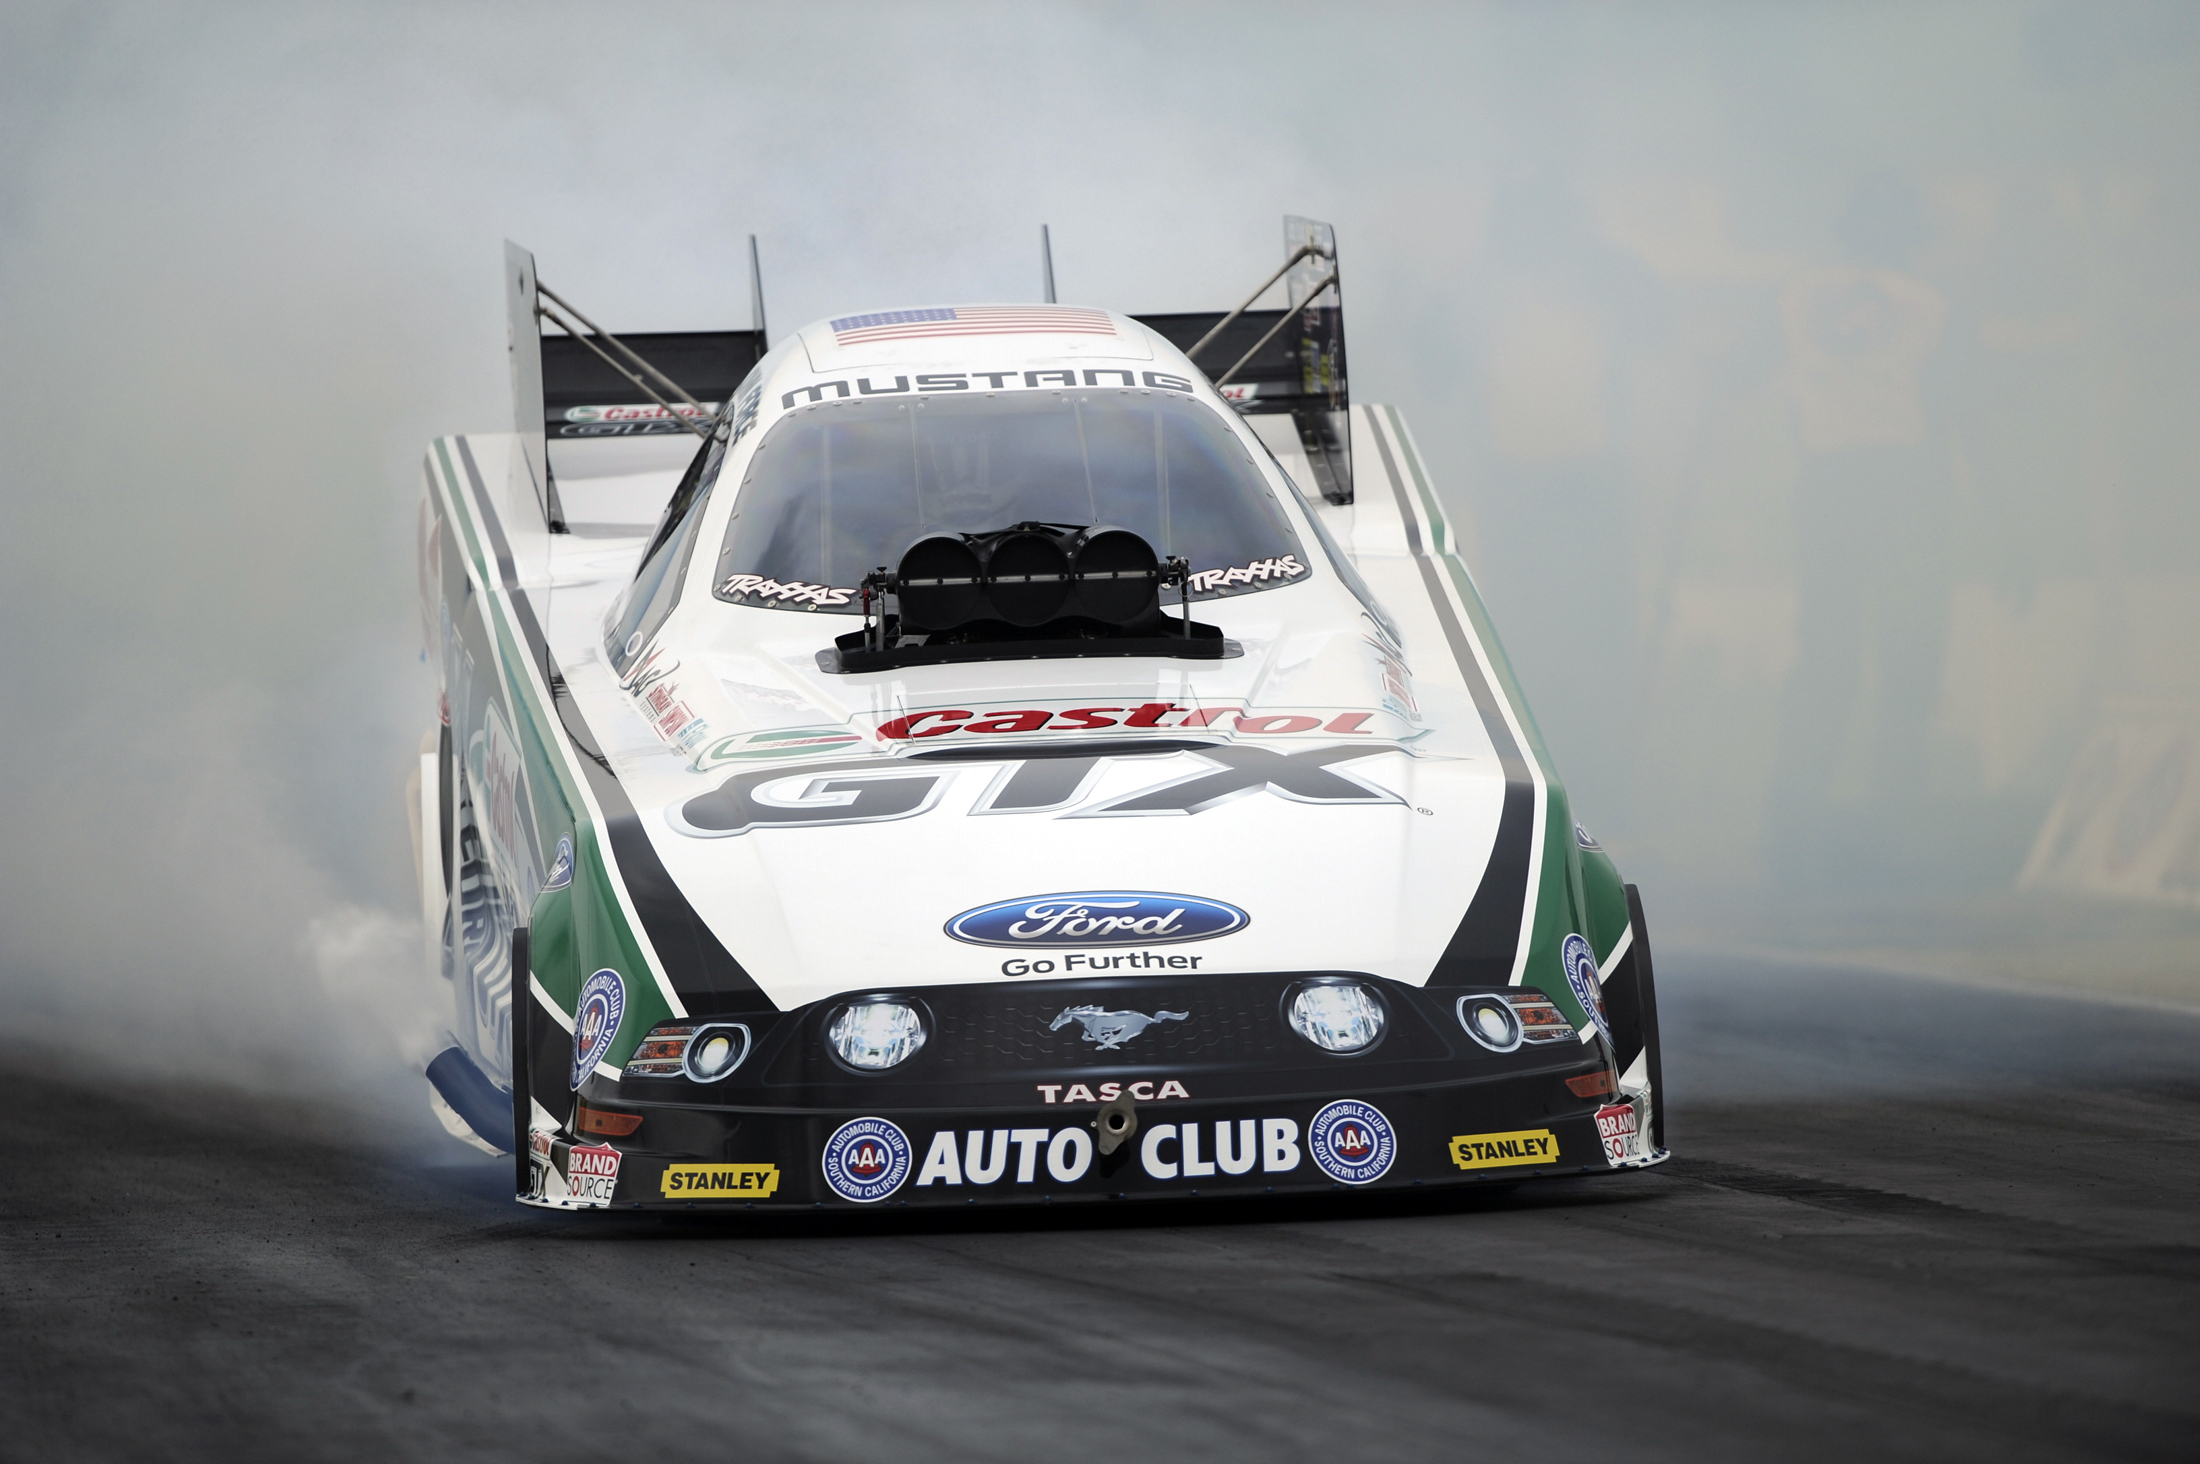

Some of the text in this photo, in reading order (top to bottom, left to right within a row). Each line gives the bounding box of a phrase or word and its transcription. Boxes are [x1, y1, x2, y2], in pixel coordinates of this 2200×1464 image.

[781, 368, 1193, 410] MUSTANG
[1187, 554, 1305, 593] TRAXXAS
[721, 573, 858, 606] TRAXXAS
[664, 740, 1413, 839] GTX
[1008, 900, 1186, 939] Ford
[1001, 951, 1203, 977] Go Further
[609, 986, 621, 1020] CLUB
[580, 1011, 603, 1041] AAA
[1037, 1079, 1190, 1104] TASCA
[1315, 1105, 1387, 1136] AUTOMOBILE CLUB
[1598, 1112, 1635, 1137] BRAND
[832, 1122, 905, 1153] AUTOMOBILE CLUB
[915, 1117, 1302, 1187] AUTO CLUB
[1334, 1129, 1372, 1150] AAA
[1457, 1137, 1549, 1162] STANLEY
[568, 1152, 618, 1176] BRAND
[848, 1147, 886, 1168] AAA
[1314, 1136, 1392, 1179] SOUTHERN CALIFORNIA
[566, 1175, 615, 1200] SOURCE
[669, 1171, 771, 1190] STANLEY
[828, 1155, 907, 1197] SOUTHERN CALIFORNIA
